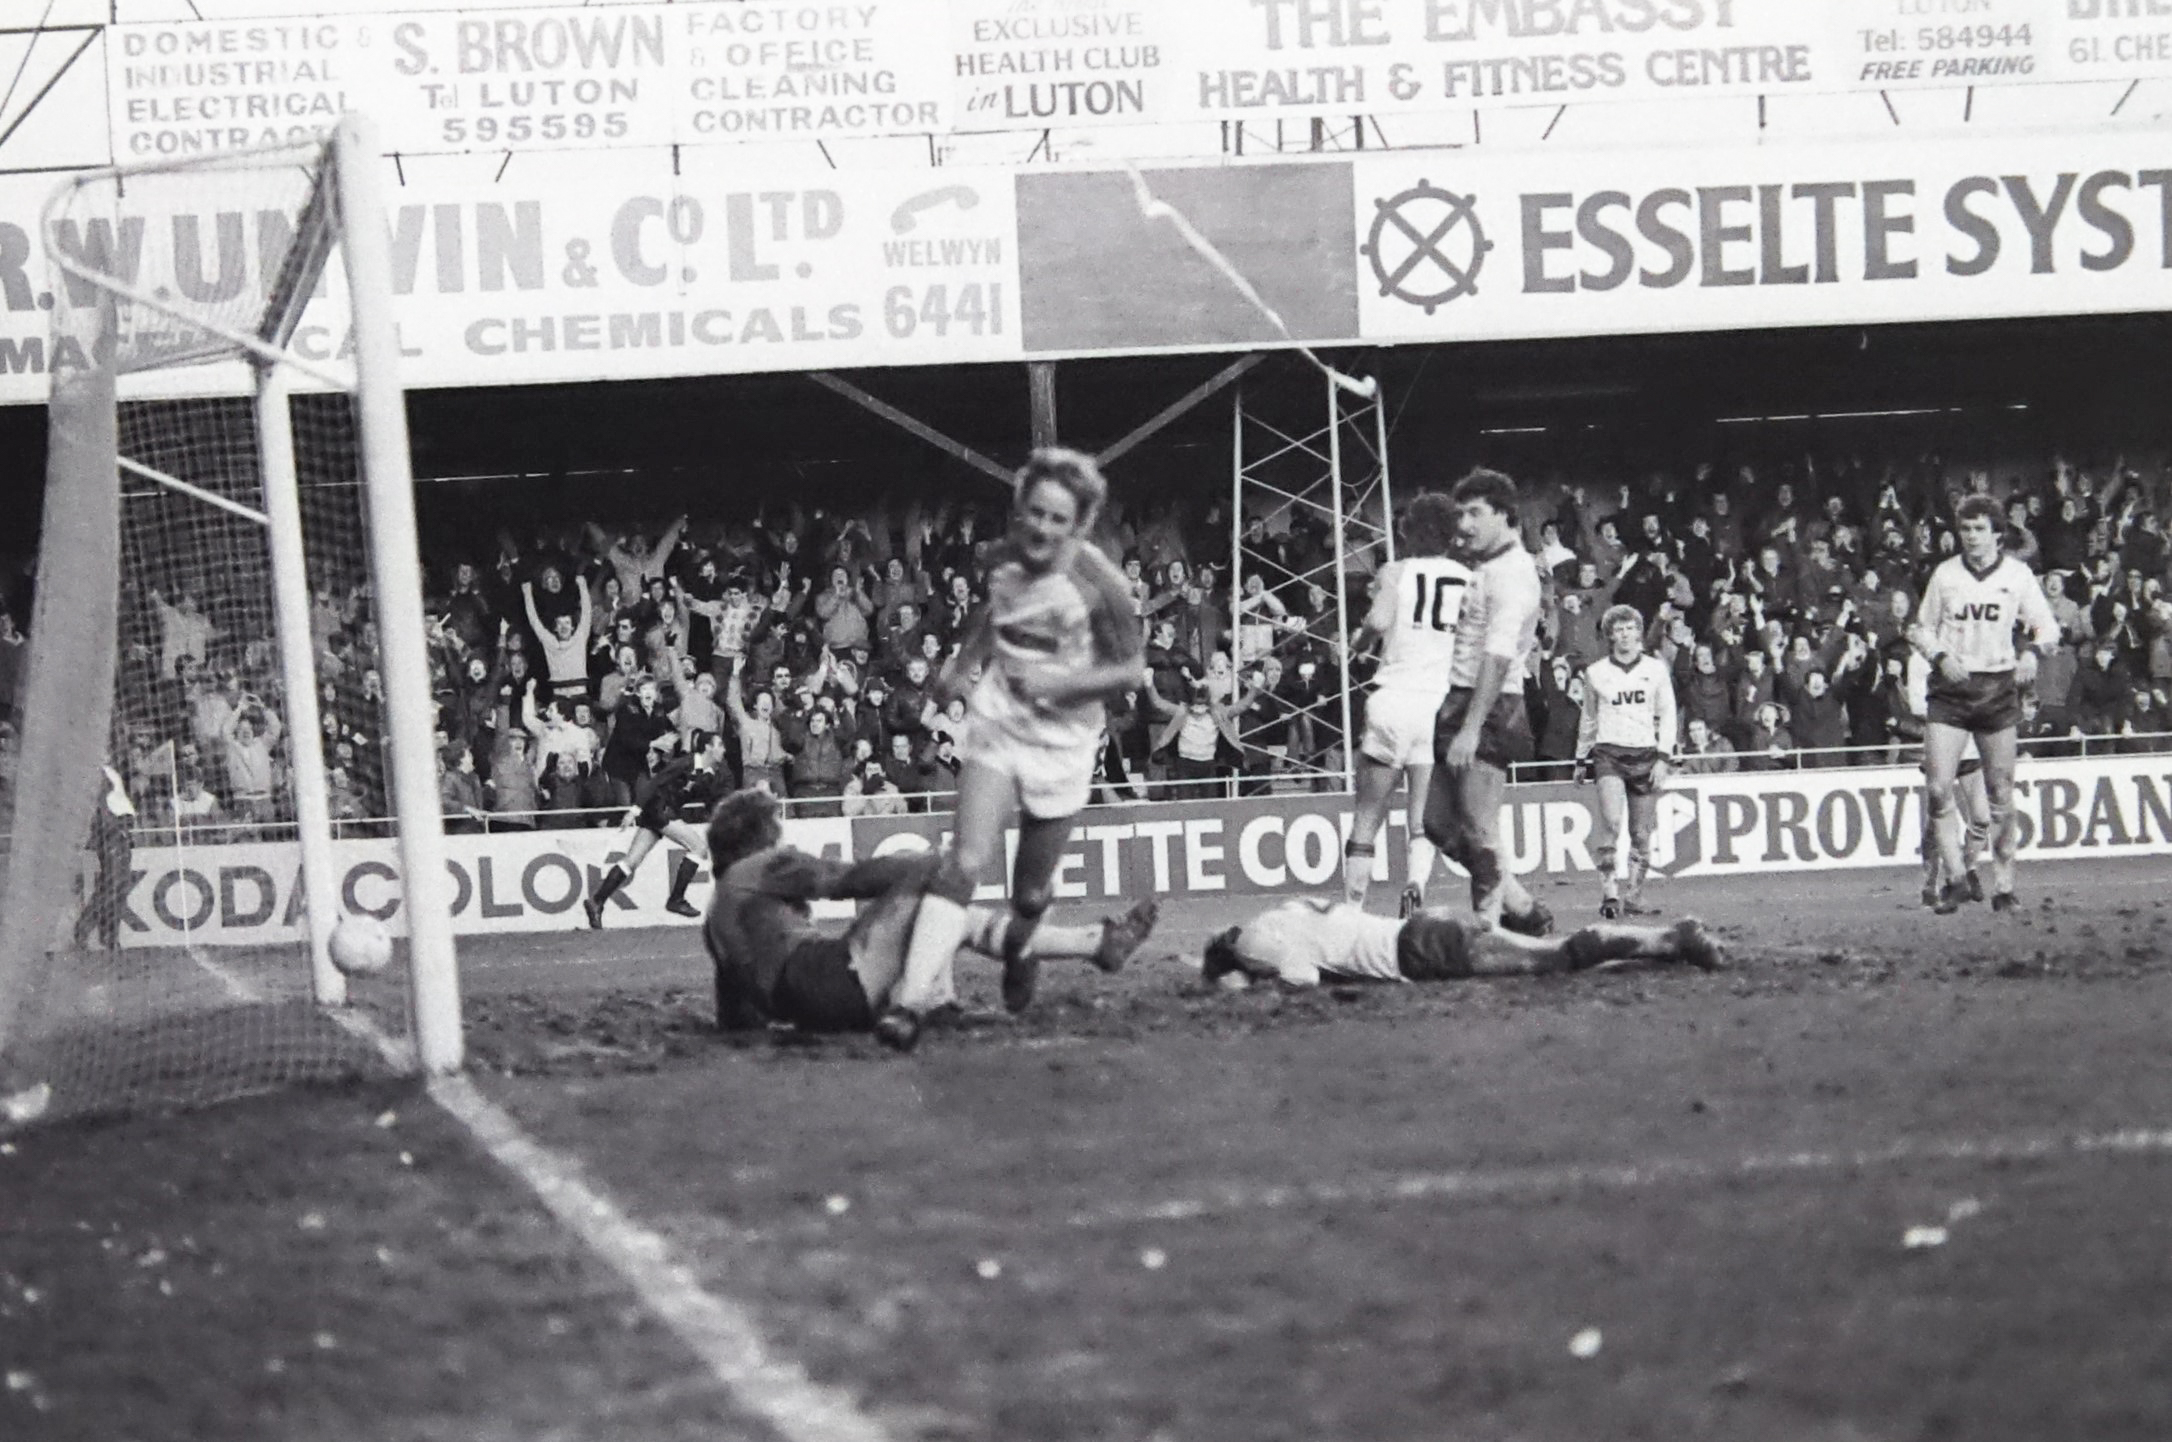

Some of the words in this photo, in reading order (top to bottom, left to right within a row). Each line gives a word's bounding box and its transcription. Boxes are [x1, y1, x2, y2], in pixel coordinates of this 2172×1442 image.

[687, 4, 878, 36] FACTORY
[973, 11, 1143, 42] EXCLUSIVE
[1250, 0, 1392, 50] THE
[124, 24, 339, 57] DOMESTIC
[393, 22, 439, 76] S.
[456, 14, 665, 75] BROWN
[1917, 22, 2033, 51] 584944
[726, 38, 873, 68] OFFICE
[955, 48, 1074, 77] HEALTH
[1083, 45, 1161, 70] CLUB
[1859, 59, 1924, 81] FREE
[1931, 54, 2036, 78] PARKING
[125, 59, 340, 89] INDUSTRIAL
[690, 70, 897, 101] CLEANING
[1198, 65, 1366, 109] HEALTH
[1388, 62, 1422, 101] &
[1444, 51, 1627, 98] FITNESS
[1645, 45, 1813, 87] CENTRE
[127, 91, 359, 123] ELECTRICAL
[480, 78, 638, 108] LUTON
[967, 86, 998, 112] in
[1004, 79, 1143, 119] LUTON
[443, 111, 628, 143] 595595
[693, 101, 939, 133] CONTRACTOR
[882, 236, 1002, 268] WELWYN
[1518, 178, 1920, 294] ESSELTE
[562, 237, 599, 288] &
[884, 282, 1002, 340] 6441
[464, 302, 864, 356] CHEMICALS
[1413, 572, 1467, 634] 10
[1955, 602, 2001, 622] JVC
[1611, 690, 1646, 706] JVC
